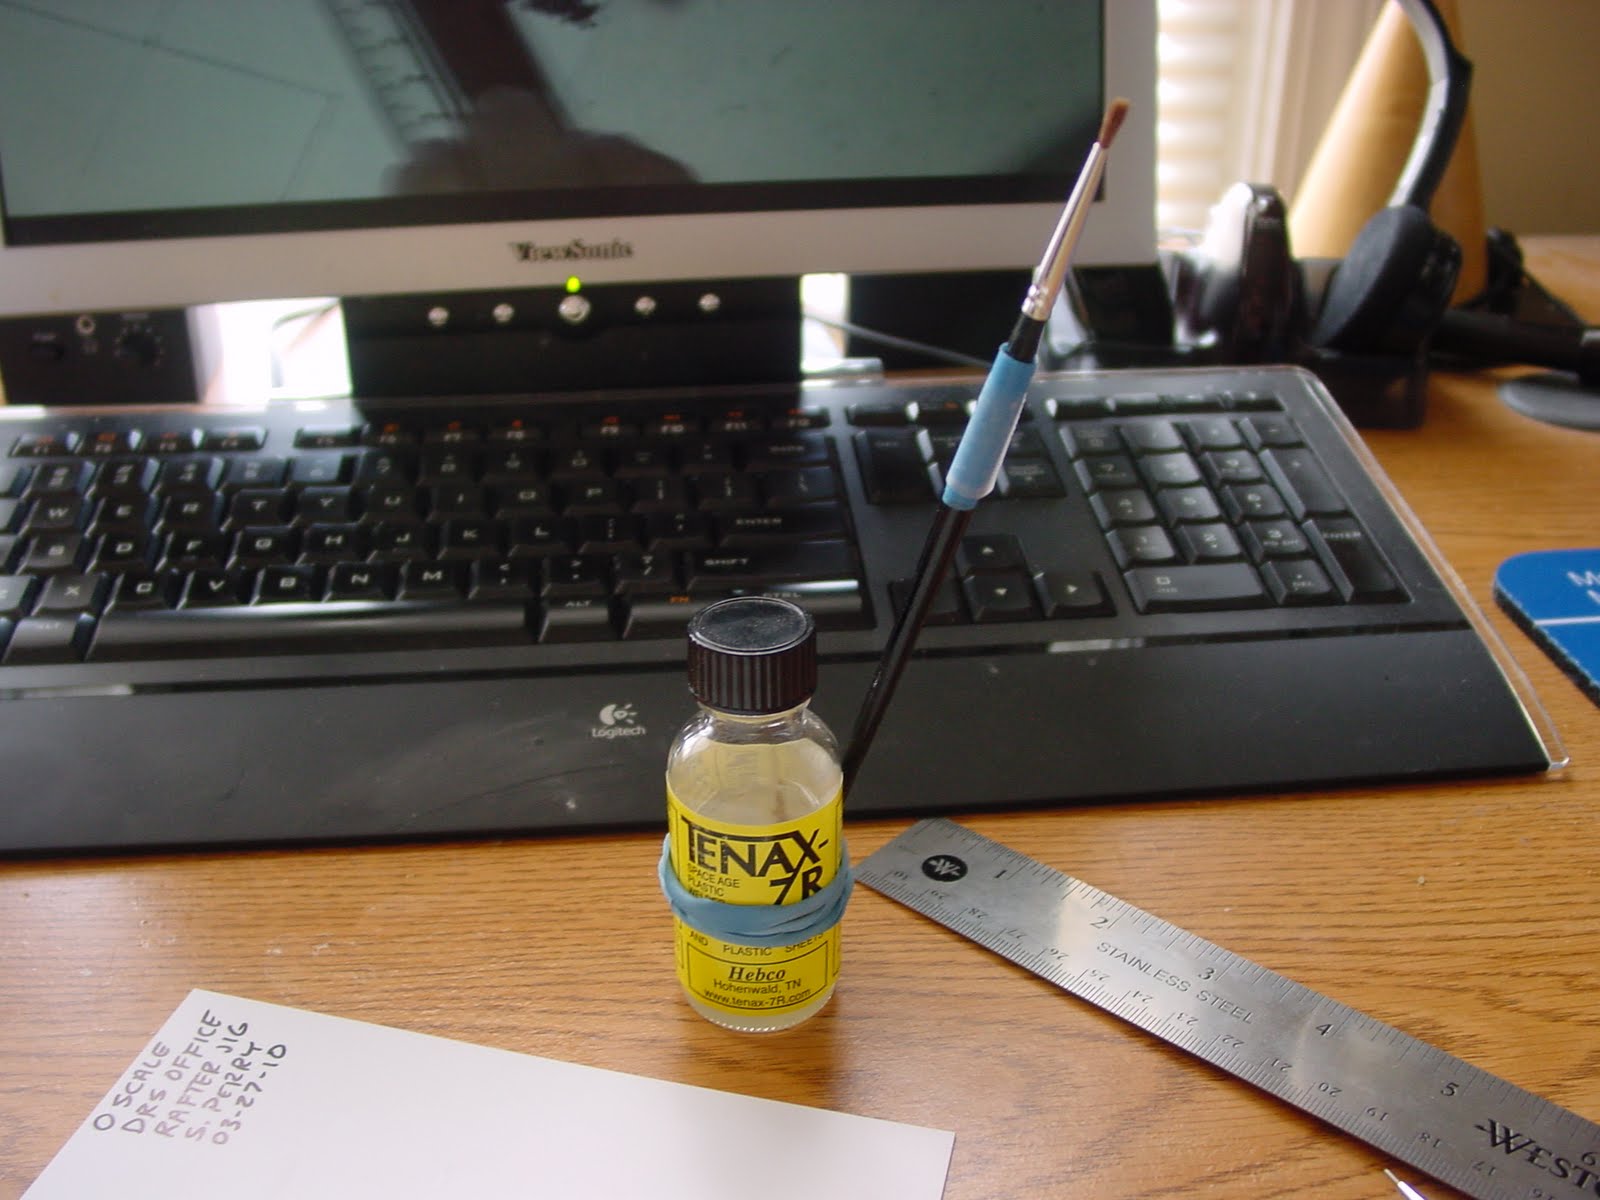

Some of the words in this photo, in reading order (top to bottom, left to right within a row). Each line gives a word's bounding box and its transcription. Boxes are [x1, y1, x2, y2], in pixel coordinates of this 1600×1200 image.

[252, 500, 268, 510] T
[320, 497, 334, 507] Y
[384, 496, 401, 506] U
[48, 507, 69, 518] W
[736, 517, 783, 526] ENTER
[396, 533, 410, 543] J
[462, 529, 478, 539] K
[535, 527, 549, 536] L
[1323, 531, 1362, 540] ENTER
[186, 540, 202, 550] F
[324, 535, 343, 545] H
[116, 542, 134, 553] D
[704, 557, 749, 566] SHIFT
[351, 574, 369, 584] N
[422, 570, 443, 581] M
[65, 586, 80, 596] X
[209, 580, 225, 591] V
[591, 725, 646, 739] Logitech
[688, 862, 715, 884] SPACE
[717, 877, 741, 889] AGE
[994, 869, 1007, 879] 1
[688, 874, 724, 897] PLASTIC
[968, 907, 989, 919] 28
[1090, 916, 1109, 929] 2
[1007, 928, 1028, 940] 27
[722, 944, 773, 957] PLASTIC
[1050, 947, 1070, 961] 26
[728, 965, 786, 982] Hebco
[1090, 969, 1110, 982] 25
[1198, 967, 1215, 981] 3
[713, 978, 781, 994] Hohenwald,
[785, 978, 802, 991] TN
[1096, 941, 1192, 993] STAINLESS
[1196, 990, 1254, 1025] STEEL
[703, 988, 811, 1007] www.tenax-7R.com
[1133, 990, 1153, 1004] 24
[1177, 1012, 1198, 1026] 23
[1315, 1022, 1334, 1036] 4
[1222, 1034, 1245, 1049] 22
[121, 1089, 166, 1134] DRS
[164, 1009, 222, 1081] OFFICE
[1271, 1058, 1293, 1073] 21
[93, 1113, 115, 1131] O
[112, 1041, 170, 1108] SCALE
[154, 1060, 220, 1138] RAFTER
[216, 1021, 248, 1054] JIG
[184, 1120, 211, 1142] S.
[201, 1041, 262, 1112] PERRY
[212, 1044, 286, 1145] 03-27-10
[1319, 1081, 1343, 1098] 20
[1440, 1082, 1460, 1097] 5
[1367, 1106, 1390, 1122] 19
[1418, 1131, 1441, 1149] 18
[1581, 1151, 1599, 1166] 6
[1472, 1160, 1497, 1177] 17
